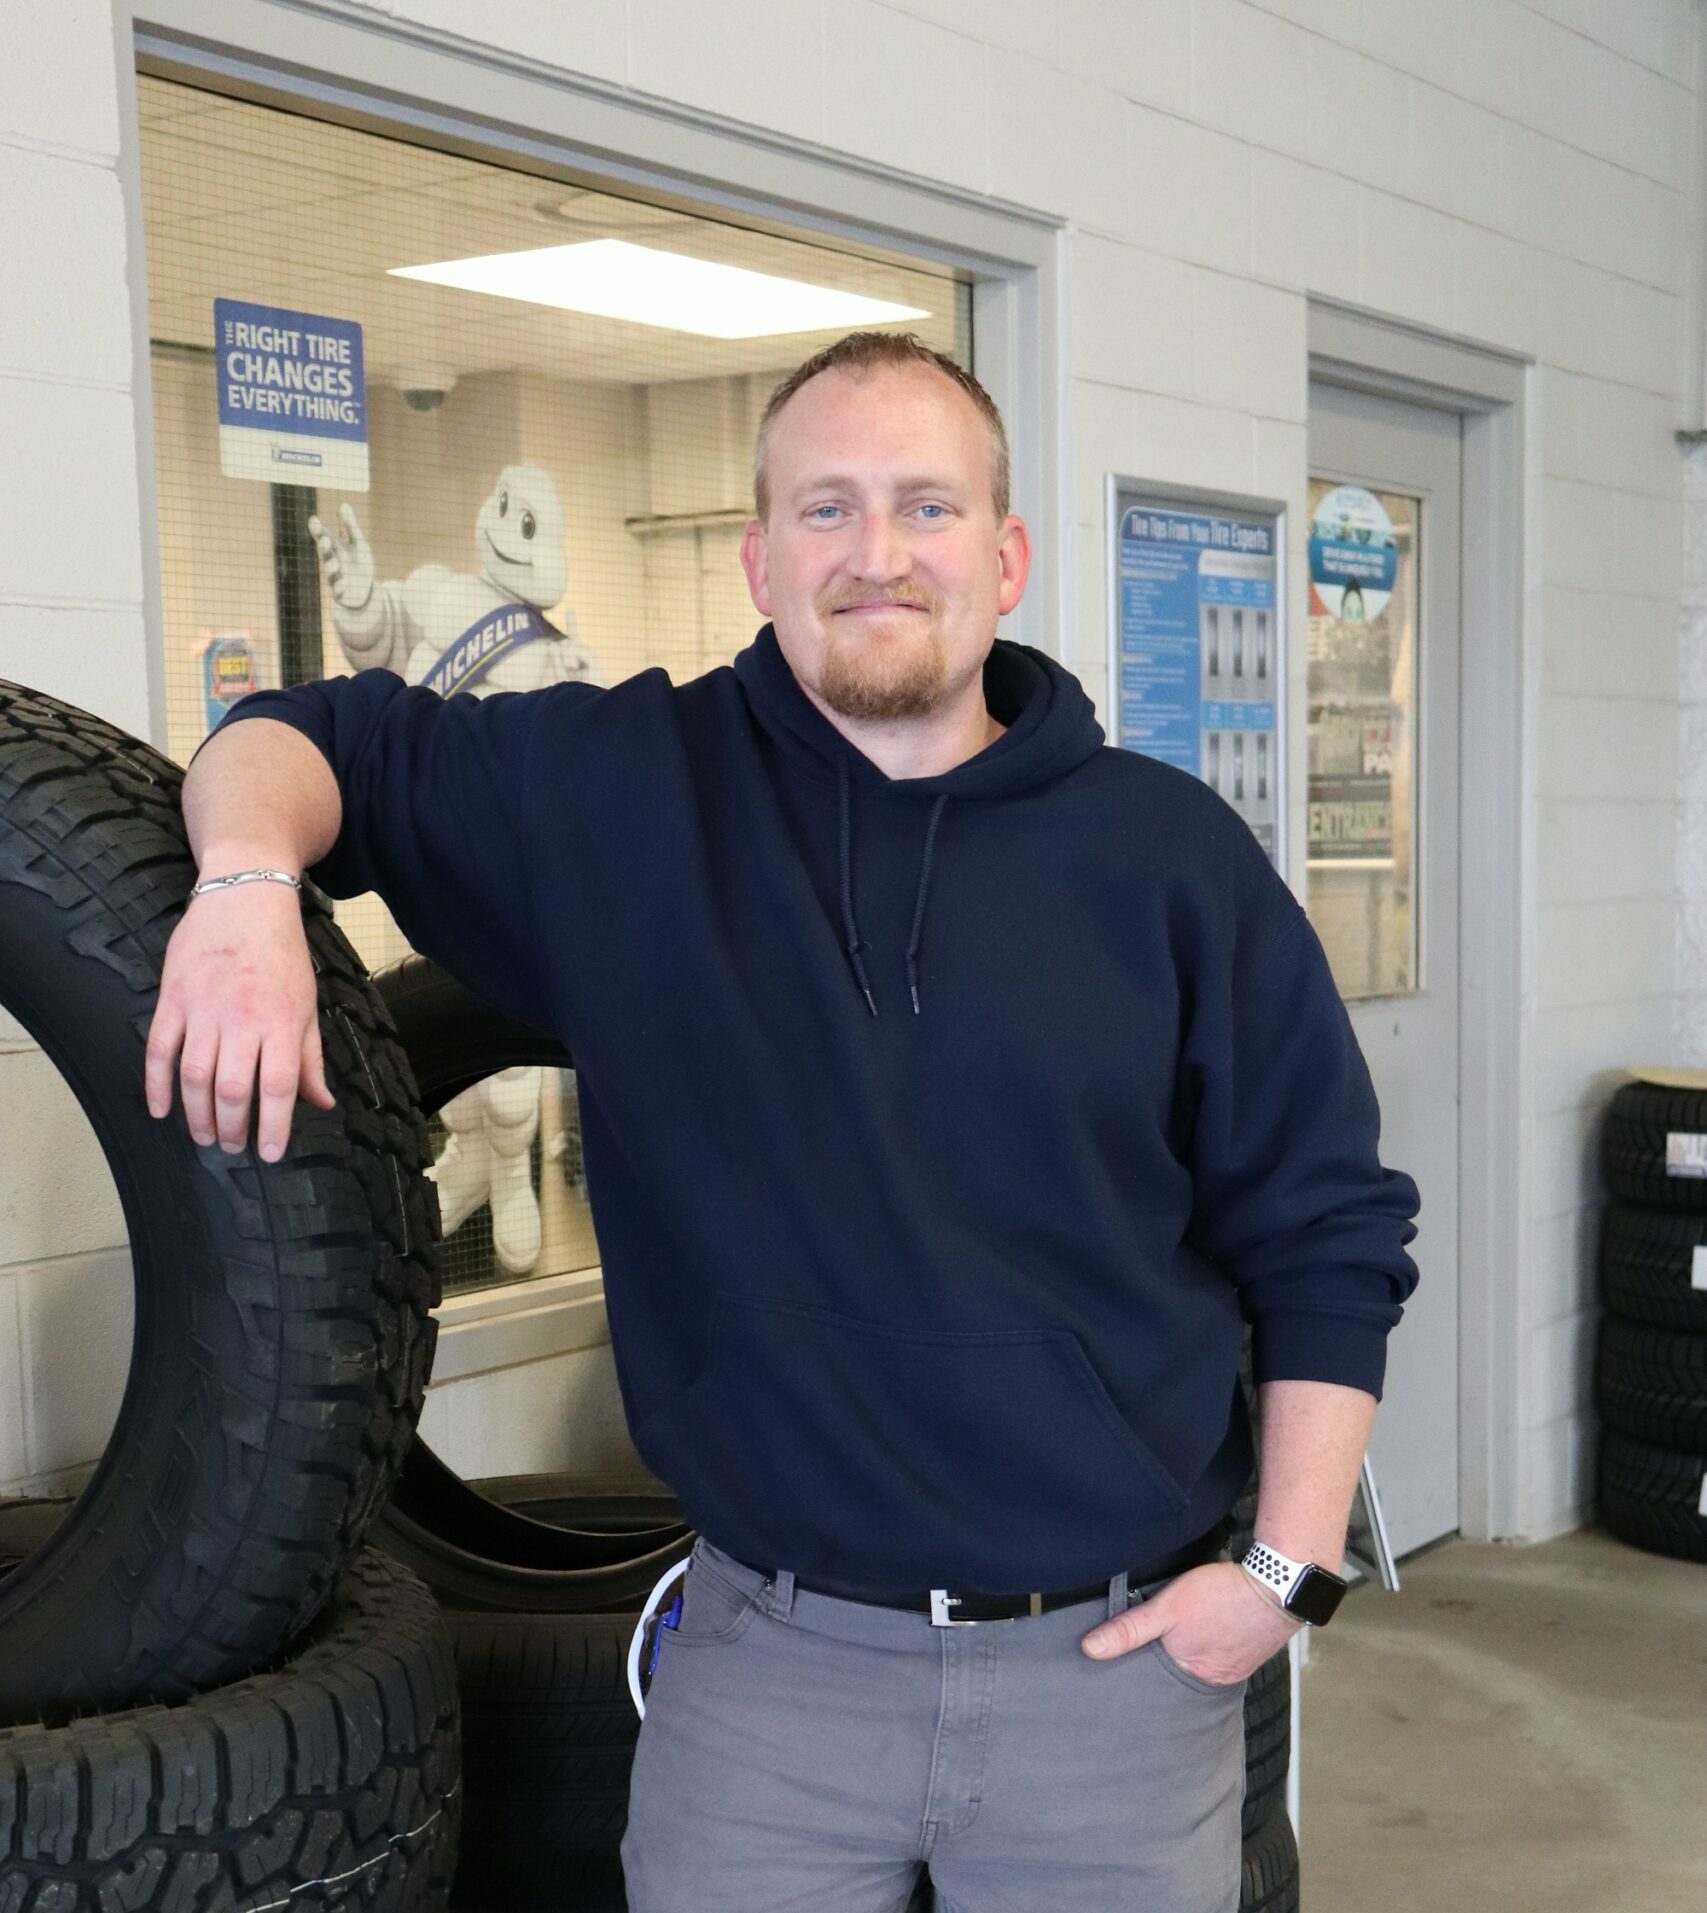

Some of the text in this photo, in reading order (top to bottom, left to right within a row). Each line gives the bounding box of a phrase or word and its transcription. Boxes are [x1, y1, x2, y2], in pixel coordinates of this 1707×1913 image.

[225, 320, 351, 364] THE RIGHT TIRE
[226, 350, 353, 397] CHANGES
[227, 384, 359, 425] EVERYTHING.
[1131, 513, 1148, 536] Tire
[1211, 520, 1230, 545] Tire
[1231, 523, 1269, 551] Experts
